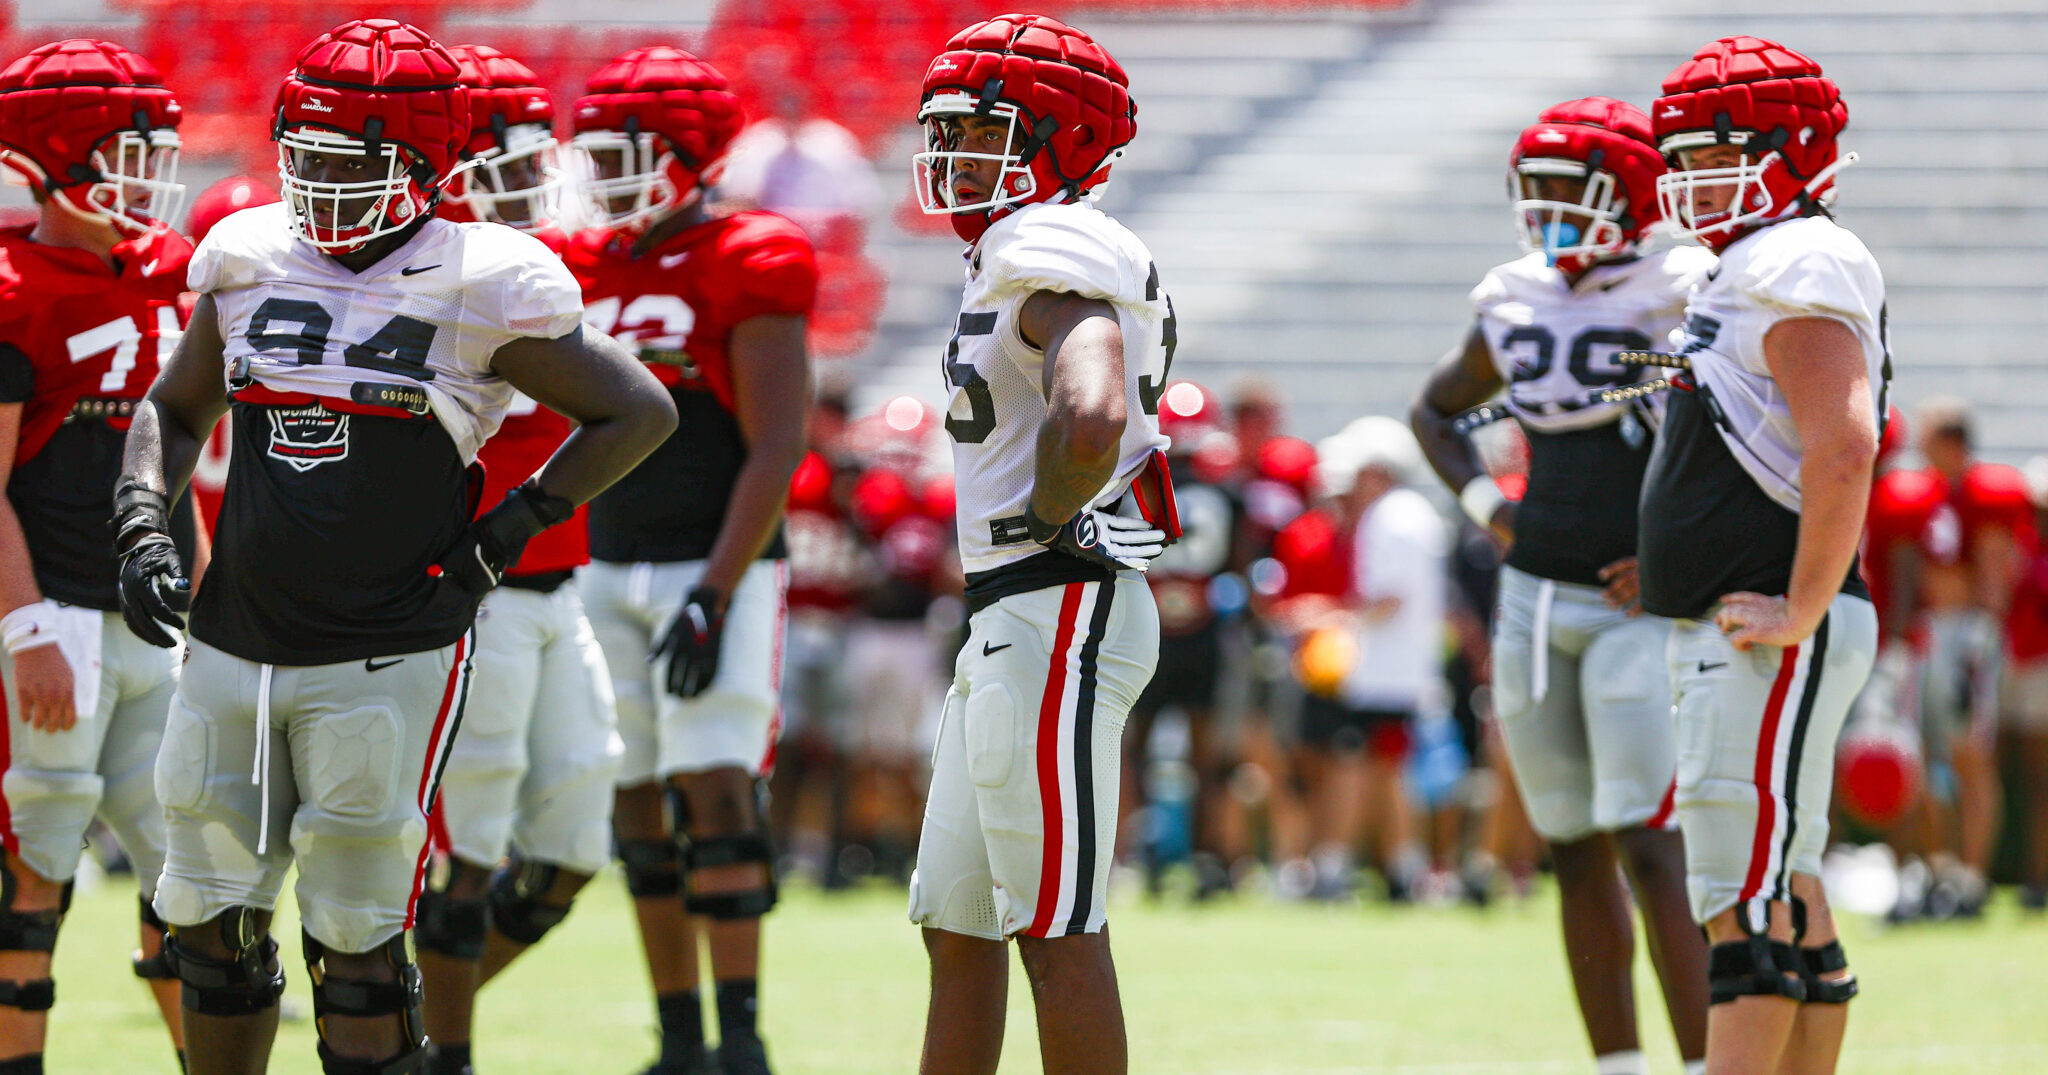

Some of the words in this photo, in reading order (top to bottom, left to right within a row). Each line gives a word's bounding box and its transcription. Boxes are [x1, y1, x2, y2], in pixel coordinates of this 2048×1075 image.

[301, 102, 333, 113] GUARDIAN
[245, 297, 438, 382] 94
[943, 310, 999, 444] 5
